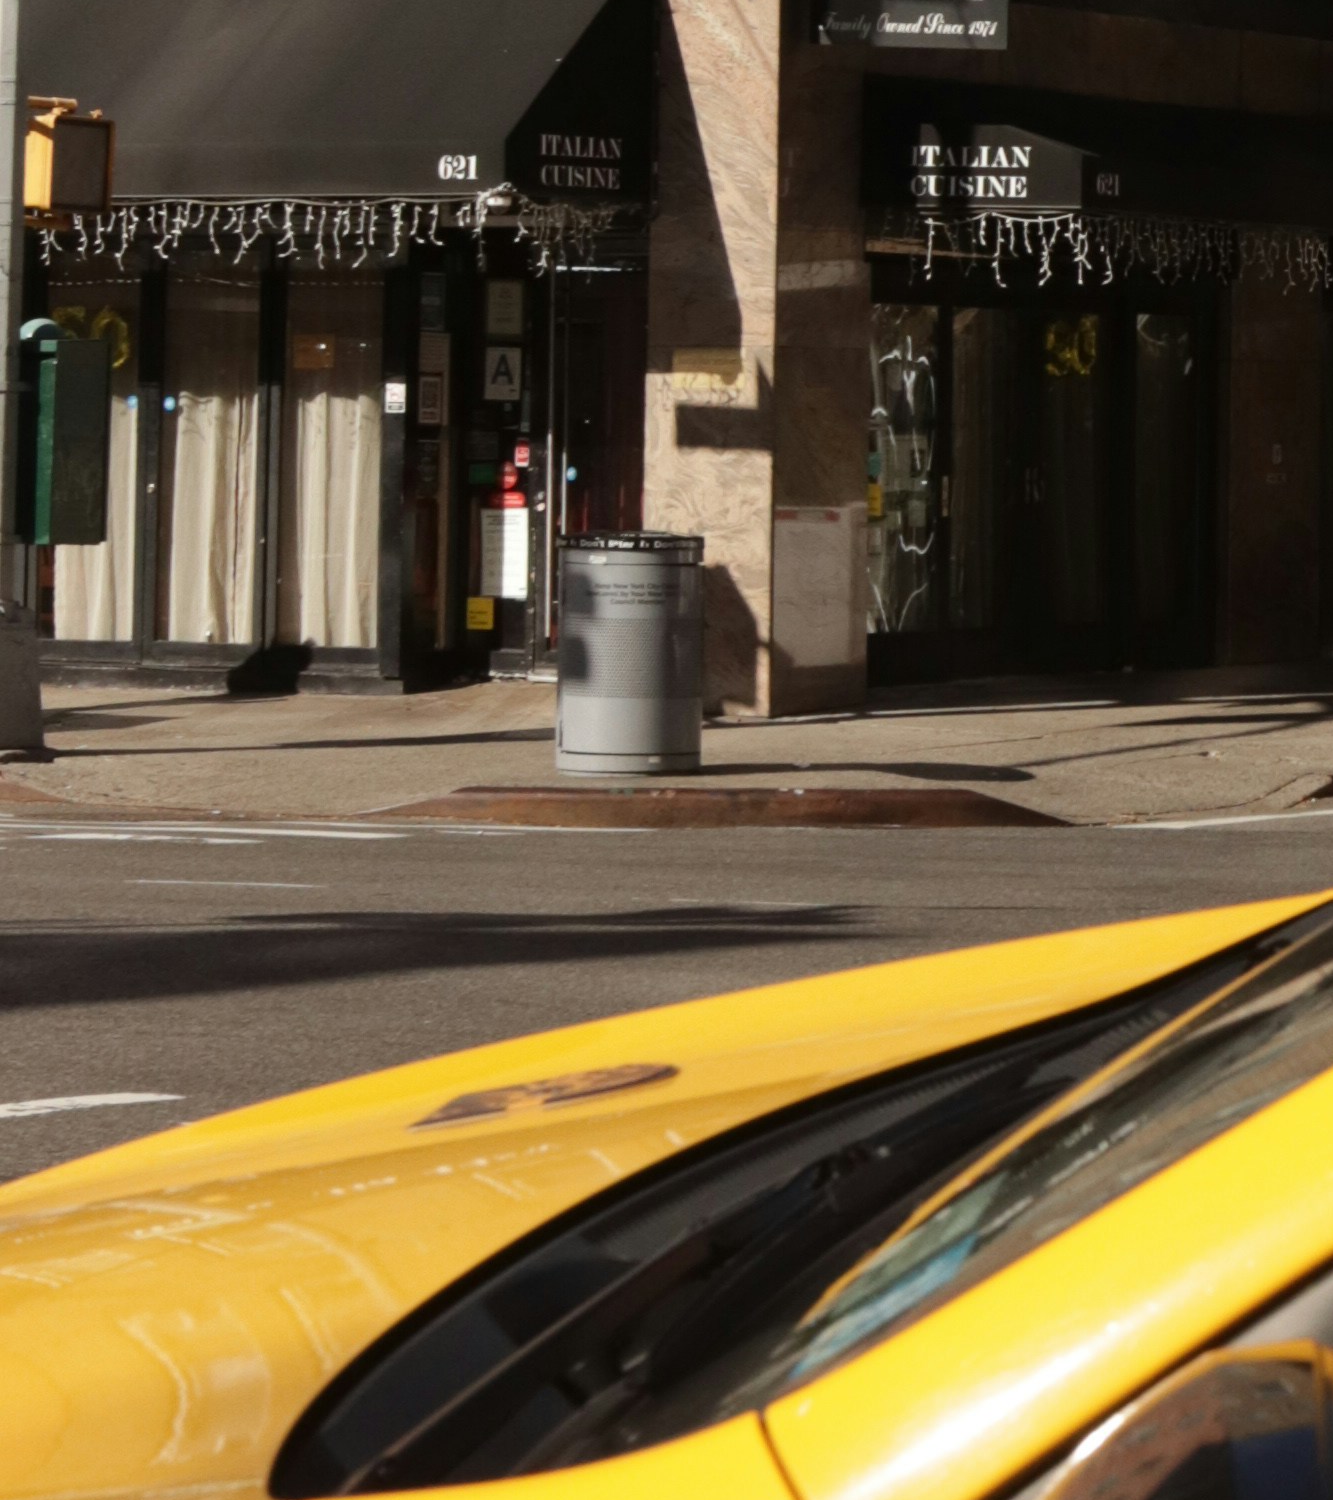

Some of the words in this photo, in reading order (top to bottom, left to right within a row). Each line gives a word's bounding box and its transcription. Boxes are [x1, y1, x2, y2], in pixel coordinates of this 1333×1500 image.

[877, 12, 924, 34] Owned
[924, 12, 965, 35] Since
[968, 20, 998, 37] 1971
[540, 133, 622, 159] ITALIAN
[910, 145, 1032, 169] ITALIAN
[437, 154, 479, 181] 621
[540, 164, 621, 190] CUISINE
[910, 174, 1028, 199] CUISINE
[1096, 171, 1121, 197] 621
[490, 352, 514, 385] A
